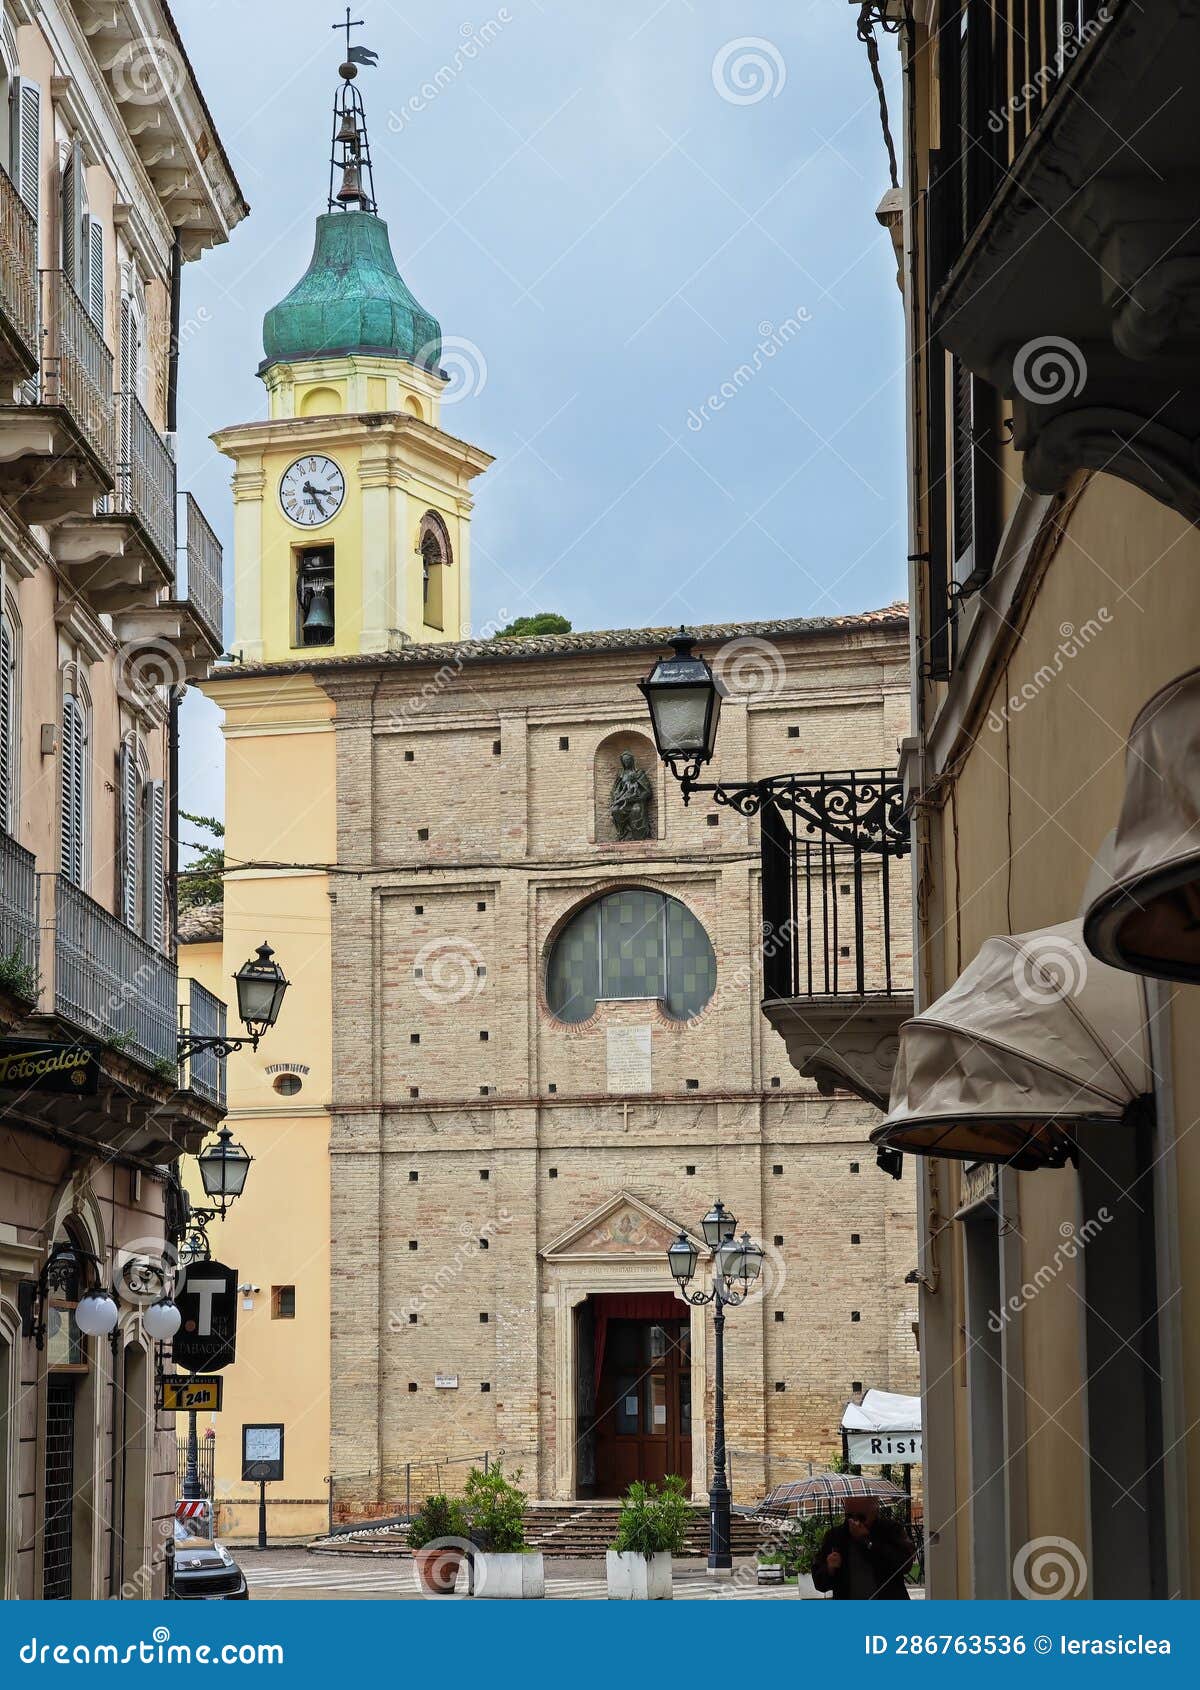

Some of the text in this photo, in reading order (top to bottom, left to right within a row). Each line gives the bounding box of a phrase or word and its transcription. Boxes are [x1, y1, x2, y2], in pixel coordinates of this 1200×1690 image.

[0, 1048, 91, 1081] Totocalcio
[187, 1279, 226, 1336] T
[170, 1385, 211, 1407] T 24h
[871, 1437, 922, 1454] Rist
